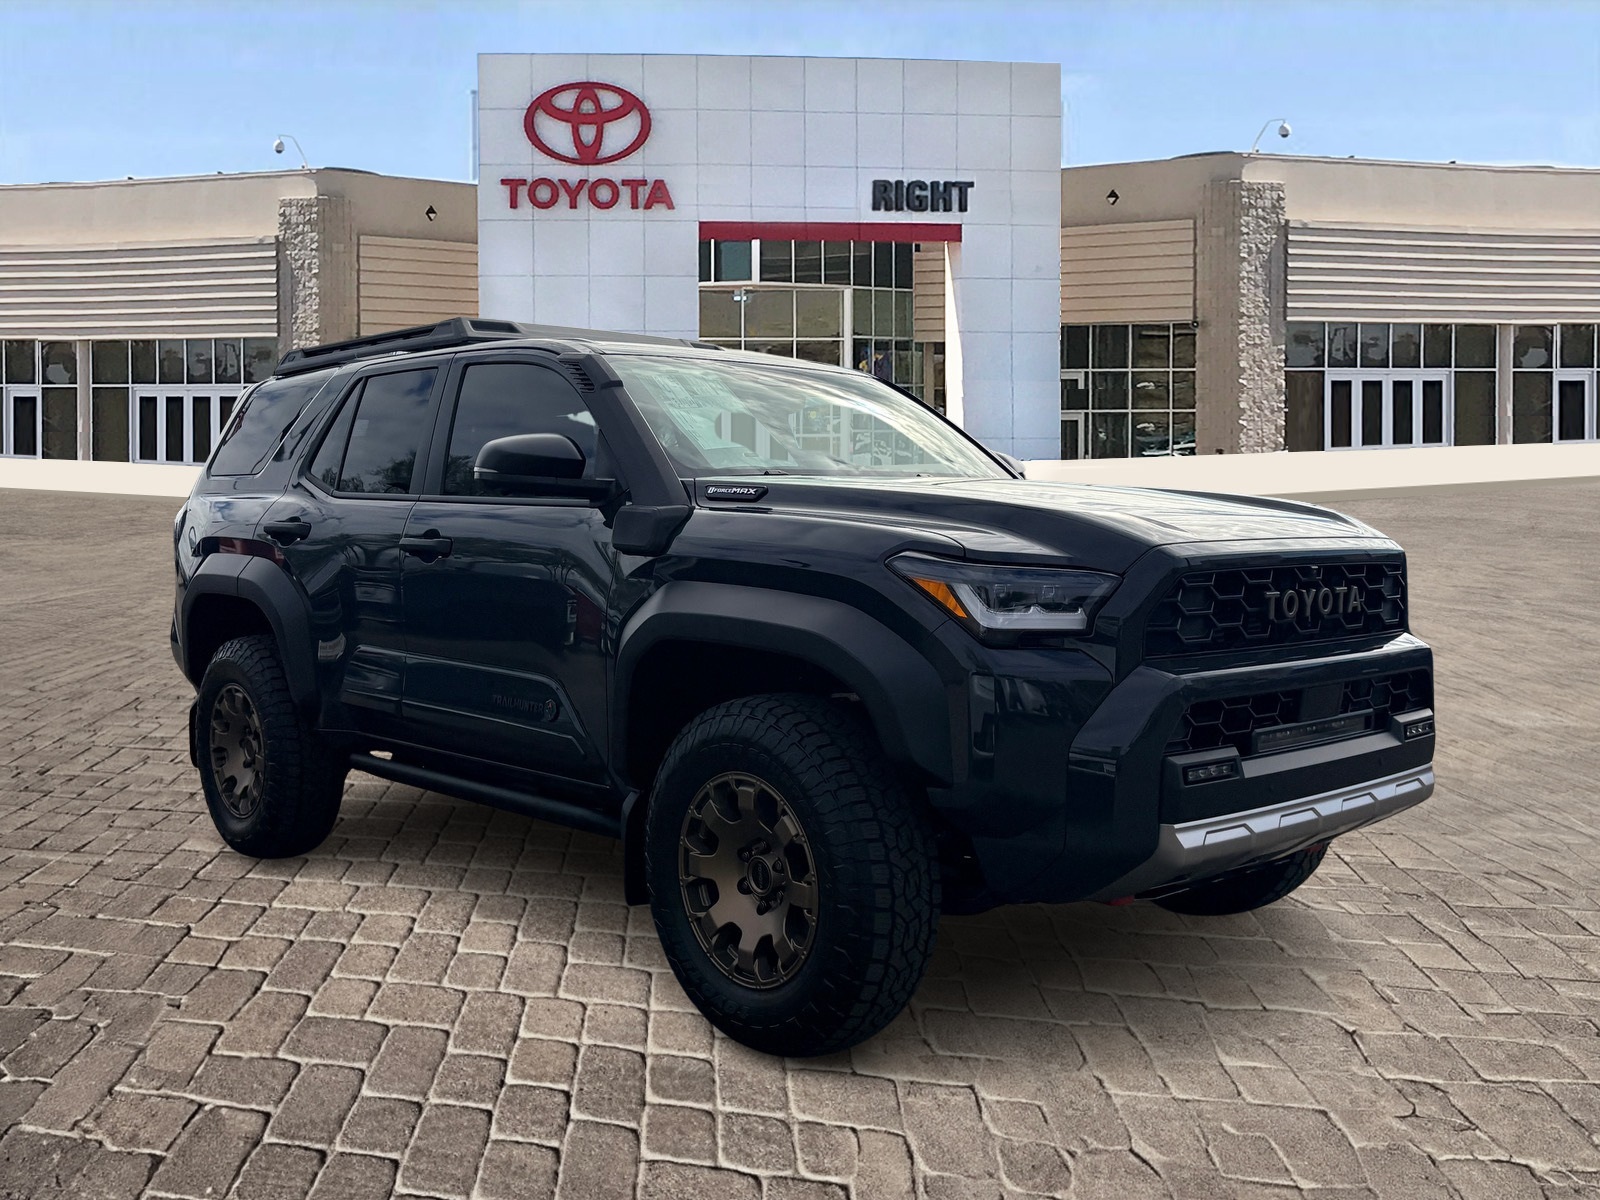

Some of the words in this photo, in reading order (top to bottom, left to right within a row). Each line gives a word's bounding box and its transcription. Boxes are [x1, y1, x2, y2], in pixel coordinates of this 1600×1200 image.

[500, 177, 675, 210] TOYOTA
[872, 179, 975, 213] RIGHT
[1264, 585, 1361, 620] TOYOTA
[492, 695, 544, 713] TRAILHUNTER
